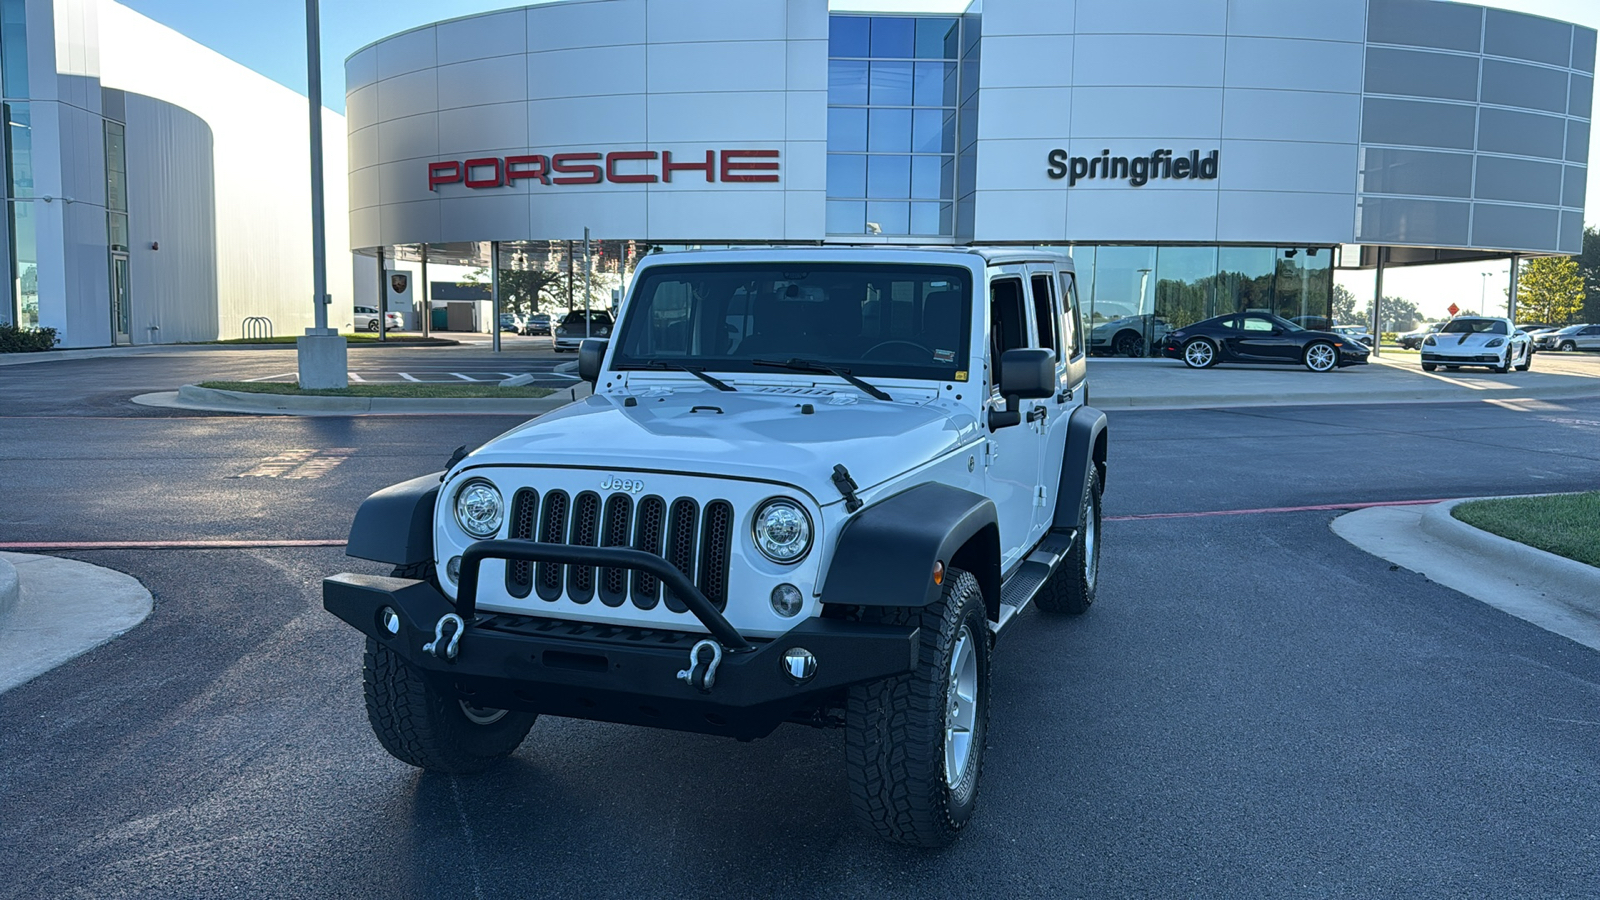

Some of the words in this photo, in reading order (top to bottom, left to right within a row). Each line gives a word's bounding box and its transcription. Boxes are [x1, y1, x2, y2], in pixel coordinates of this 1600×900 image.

[428, 150, 780, 192] PORSCHE
[1047, 149, 1219, 187] Springfield
[600, 474, 644, 495] Jeep
